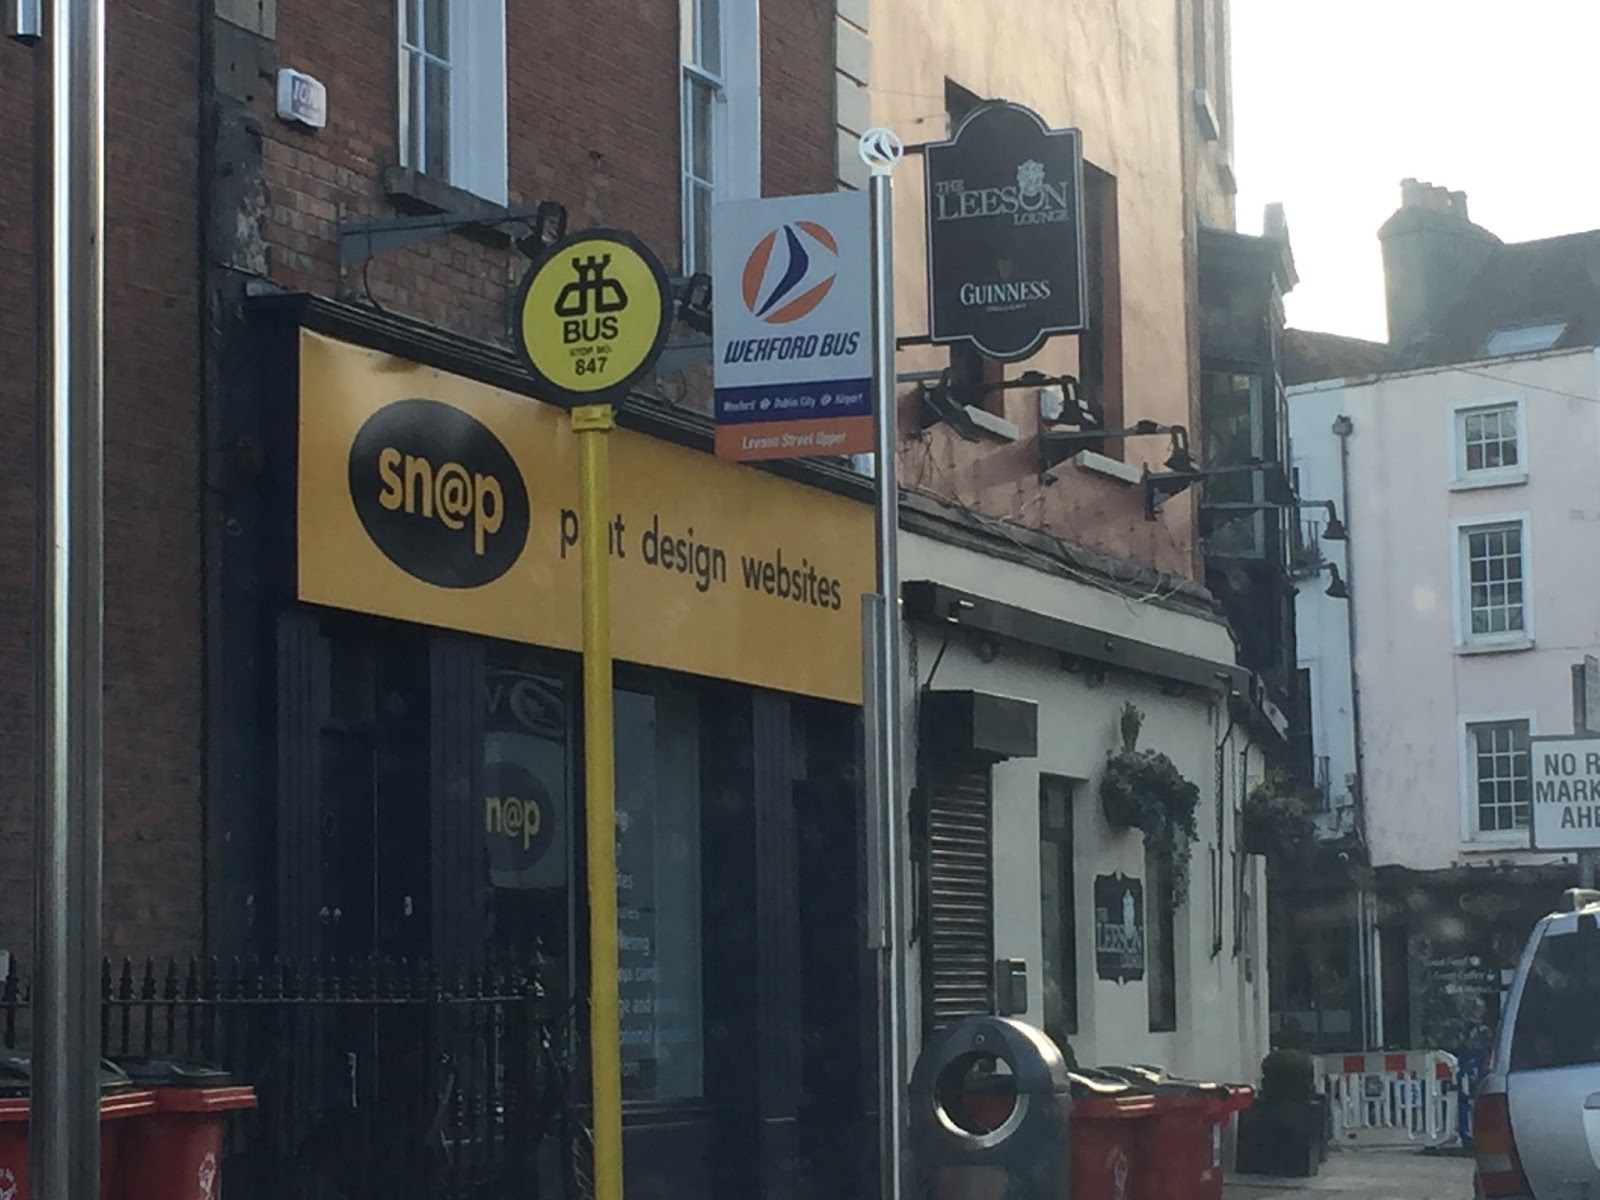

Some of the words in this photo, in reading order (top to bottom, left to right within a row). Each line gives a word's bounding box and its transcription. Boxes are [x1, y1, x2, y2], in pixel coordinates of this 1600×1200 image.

[936, 179, 965, 195] THE
[936, 181, 1069, 221] LEESON
[1013, 211, 1069, 226] LOUNGE
[960, 280, 1051, 306] GUINNESS
[563, 315, 619, 344] BUS
[724, 334, 818, 365] WEXFORD
[819, 331, 861, 358] BUS
[742, 435, 779, 450] Leeson
[781, 432, 814, 448] Street
[379, 446, 504, 556] sn@p
[641, 514, 727, 592] design
[741, 548, 842, 611] websites
[1544, 752, 1576, 777] NO
[485, 796, 541, 850] n@p
